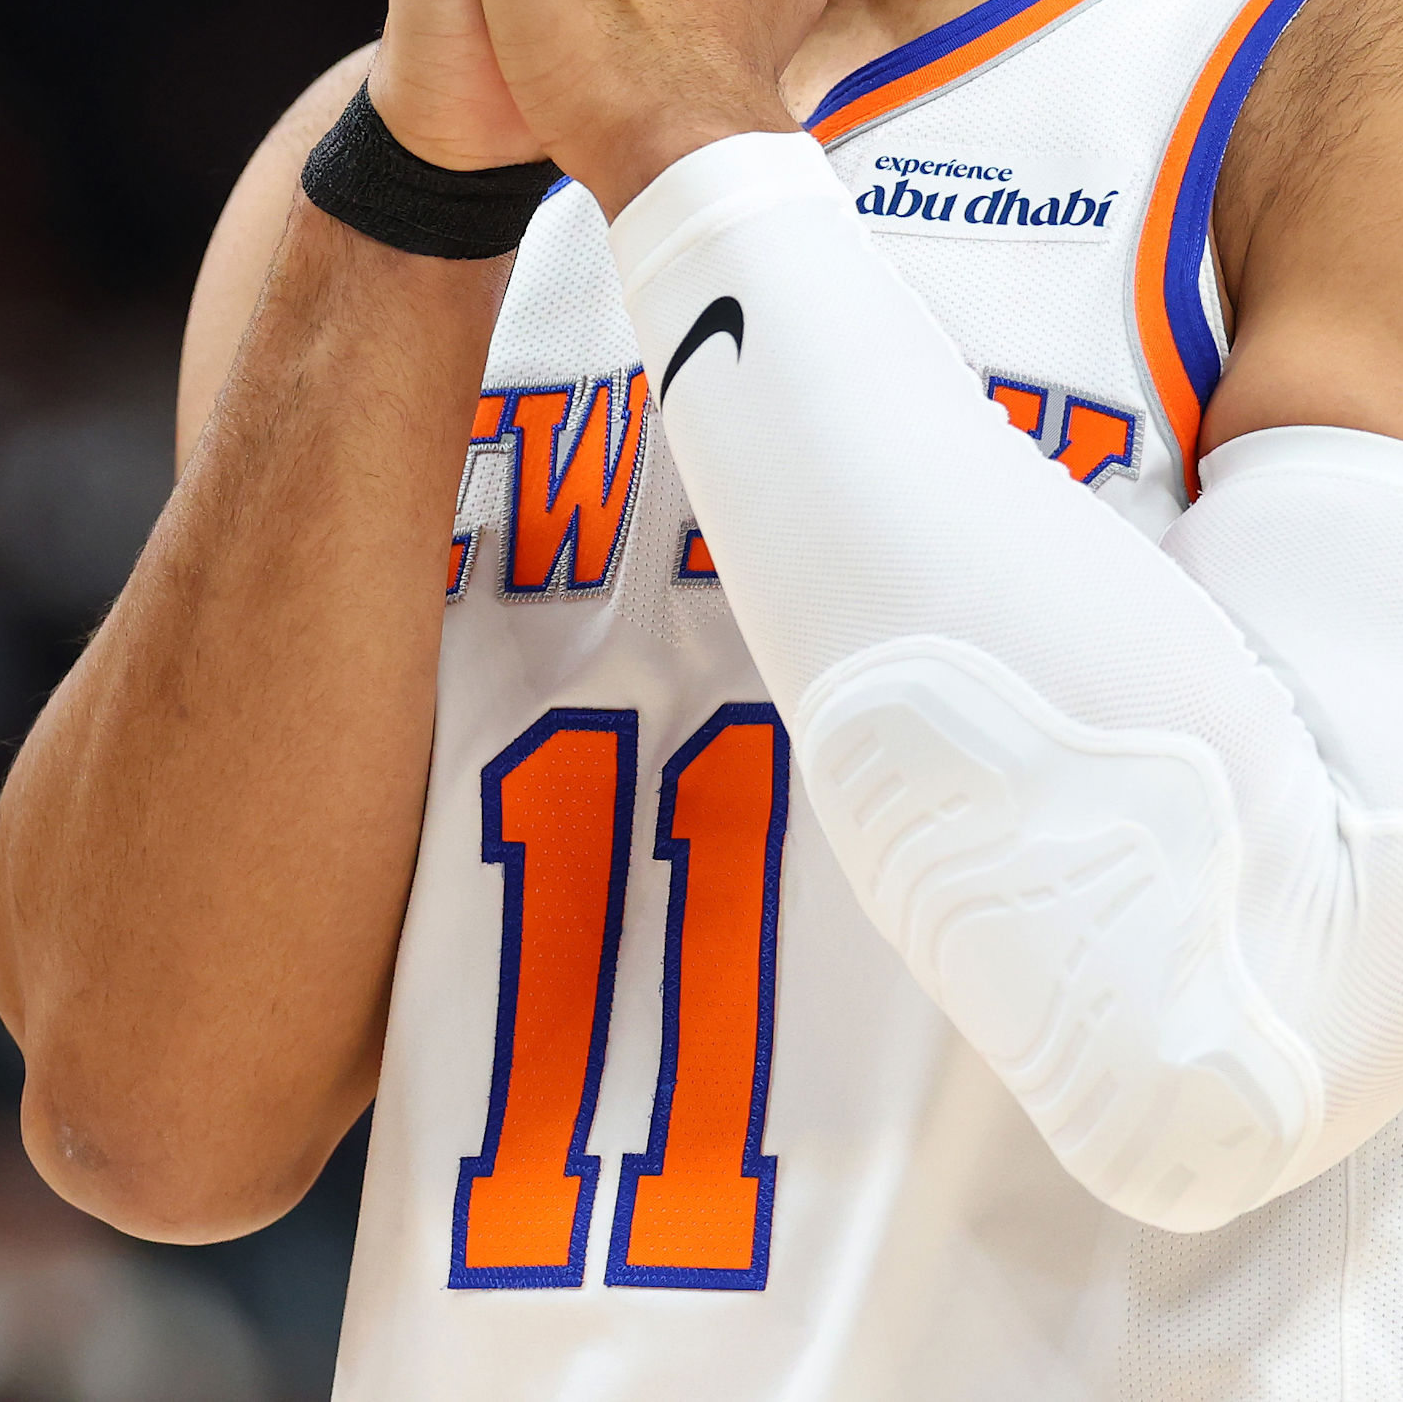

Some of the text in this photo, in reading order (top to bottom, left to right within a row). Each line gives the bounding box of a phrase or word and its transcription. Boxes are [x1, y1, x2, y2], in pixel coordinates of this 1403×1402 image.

[874, 155, 1014, 182] experience
[855, 178, 958, 222] abu
[448, 702, 791, 1291] 11
